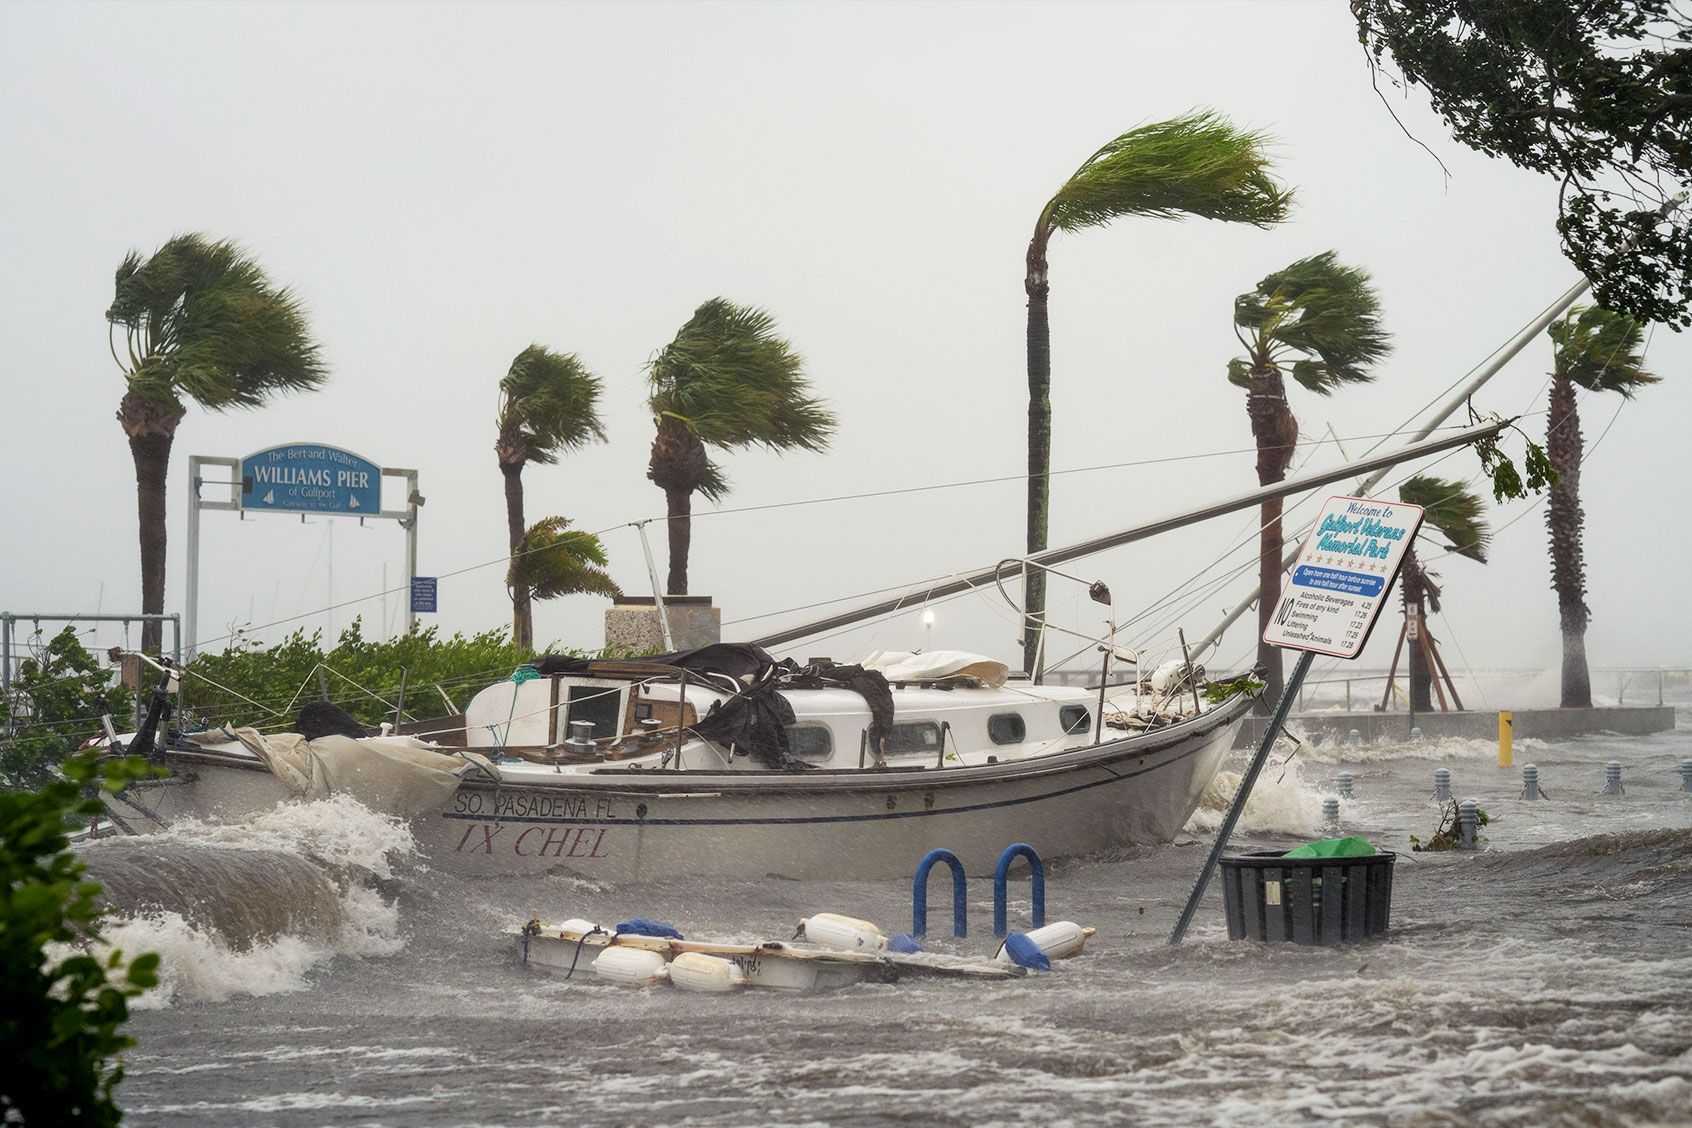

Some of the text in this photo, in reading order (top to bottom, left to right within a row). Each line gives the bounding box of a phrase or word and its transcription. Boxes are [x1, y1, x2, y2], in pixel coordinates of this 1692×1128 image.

[267, 449, 358, 467] The Bert and Walter
[254, 465, 369, 489] WILLIAMS PIER
[288, 487, 336, 500] of Gulfport
[1346, 502, 1393, 518] Welcome to
[1317, 513, 1406, 541] Gulfport Veterans
[1316, 532, 1392, 560] Memorial Park
[1303, 568, 1377, 586] Open from one half hour before sunrise
[1313, 579, 1322, 587] one
[1321, 579, 1330, 588] half
[1329, 581, 1338, 589] hour
[1337, 582, 1347, 590] after
[1346, 584, 1363, 593] sunset
[1295, 600, 1309, 609] Fires
[1309, 602, 1317, 610] of
[1316, 605, 1327, 613] any
[1326, 605, 1340, 614] kind
[1299, 591, 1325, 602] Alcoholic
[1324, 594, 1354, 608] Beverages
[1273, 597, 1295, 626] NO
[1290, 610, 1319, 623] Swimming
[1286, 620, 1309, 631] Littering
[1282, 629, 1311, 640] Unleashed
[1310, 633, 1333, 645] Animals
[454, 793, 616, 818] SO. PASADENA FL
[454, 824, 611, 858] IX CHEL
